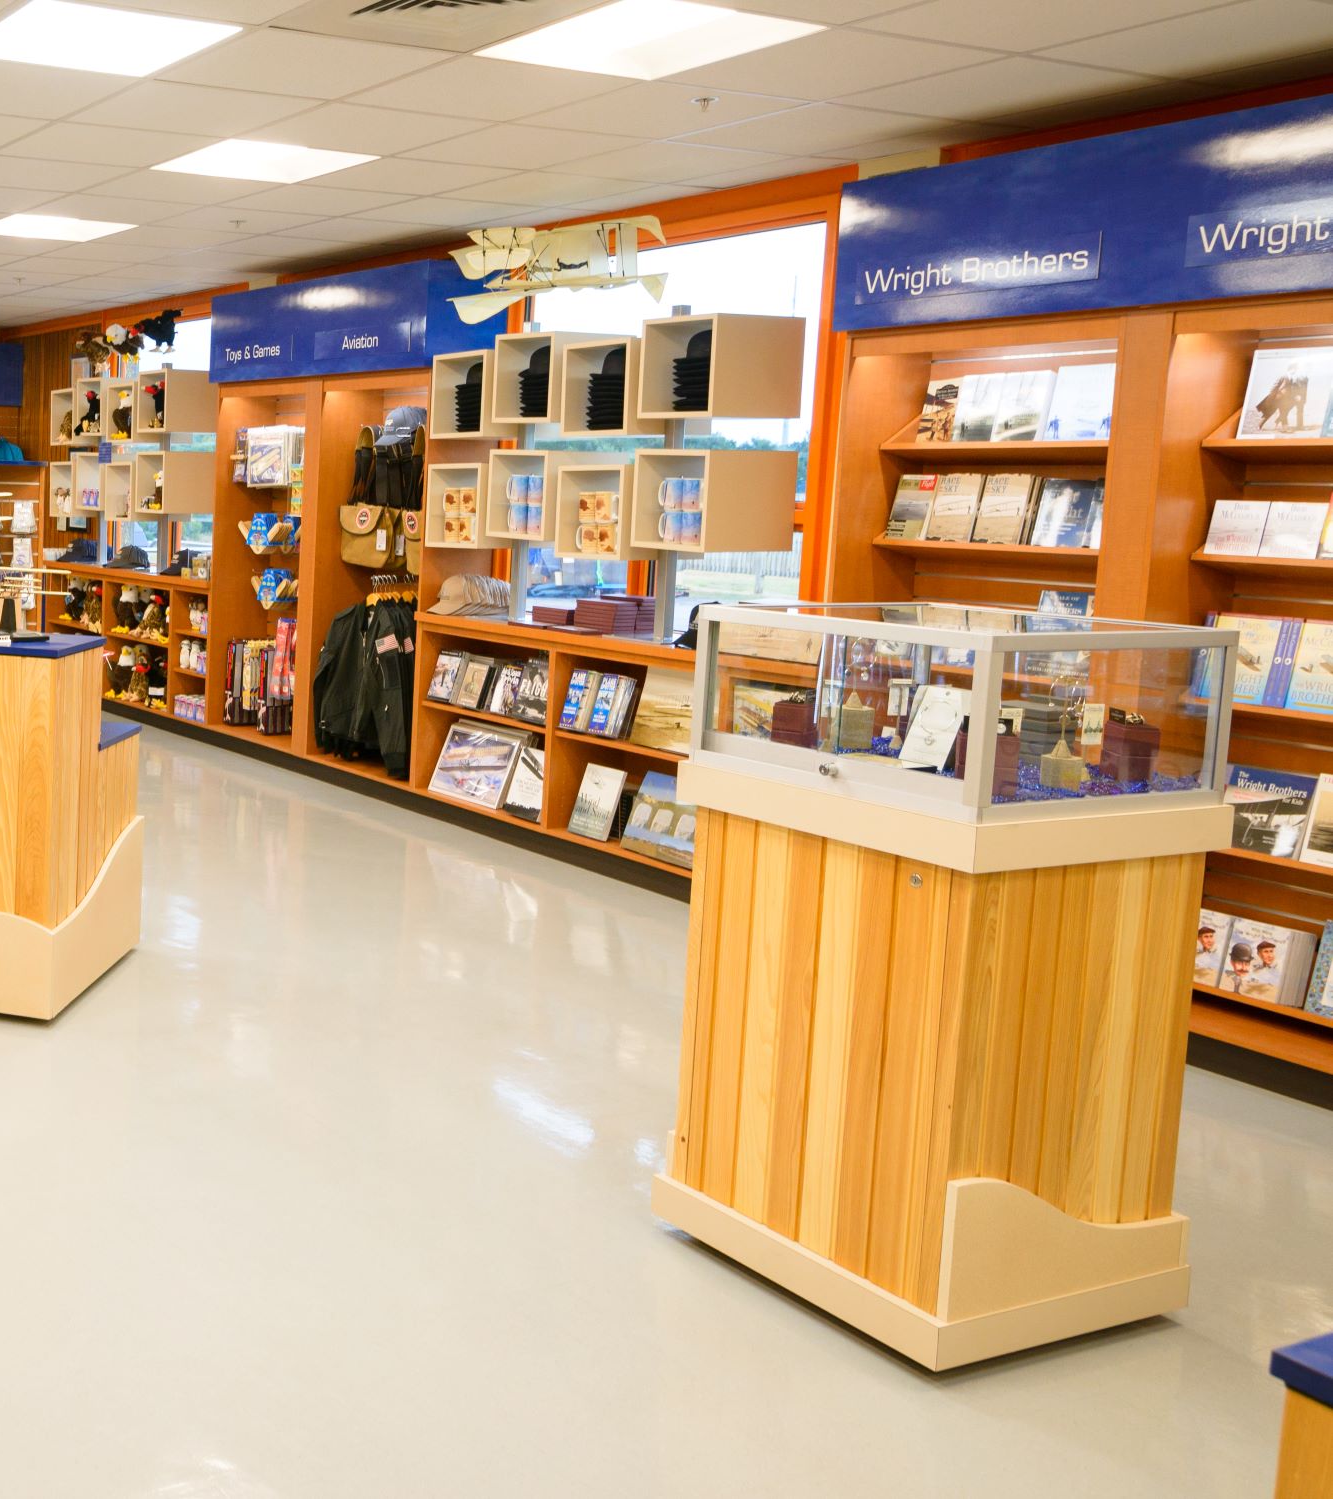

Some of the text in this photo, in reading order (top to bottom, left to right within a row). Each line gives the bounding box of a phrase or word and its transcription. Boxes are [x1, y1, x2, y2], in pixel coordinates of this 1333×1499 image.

[1199, 214, 1330, 255] Wright
[865, 250, 1089, 296] Wright Brothers
[342, 333, 379, 351] Aviation
[225, 343, 281, 364] Toys & Games
[520, 678, 549, 698] FLIGH
[1238, 770, 1250, 779] The
[1237, 778, 1268, 793] Wright
[1267, 783, 1309, 799] Brothers
